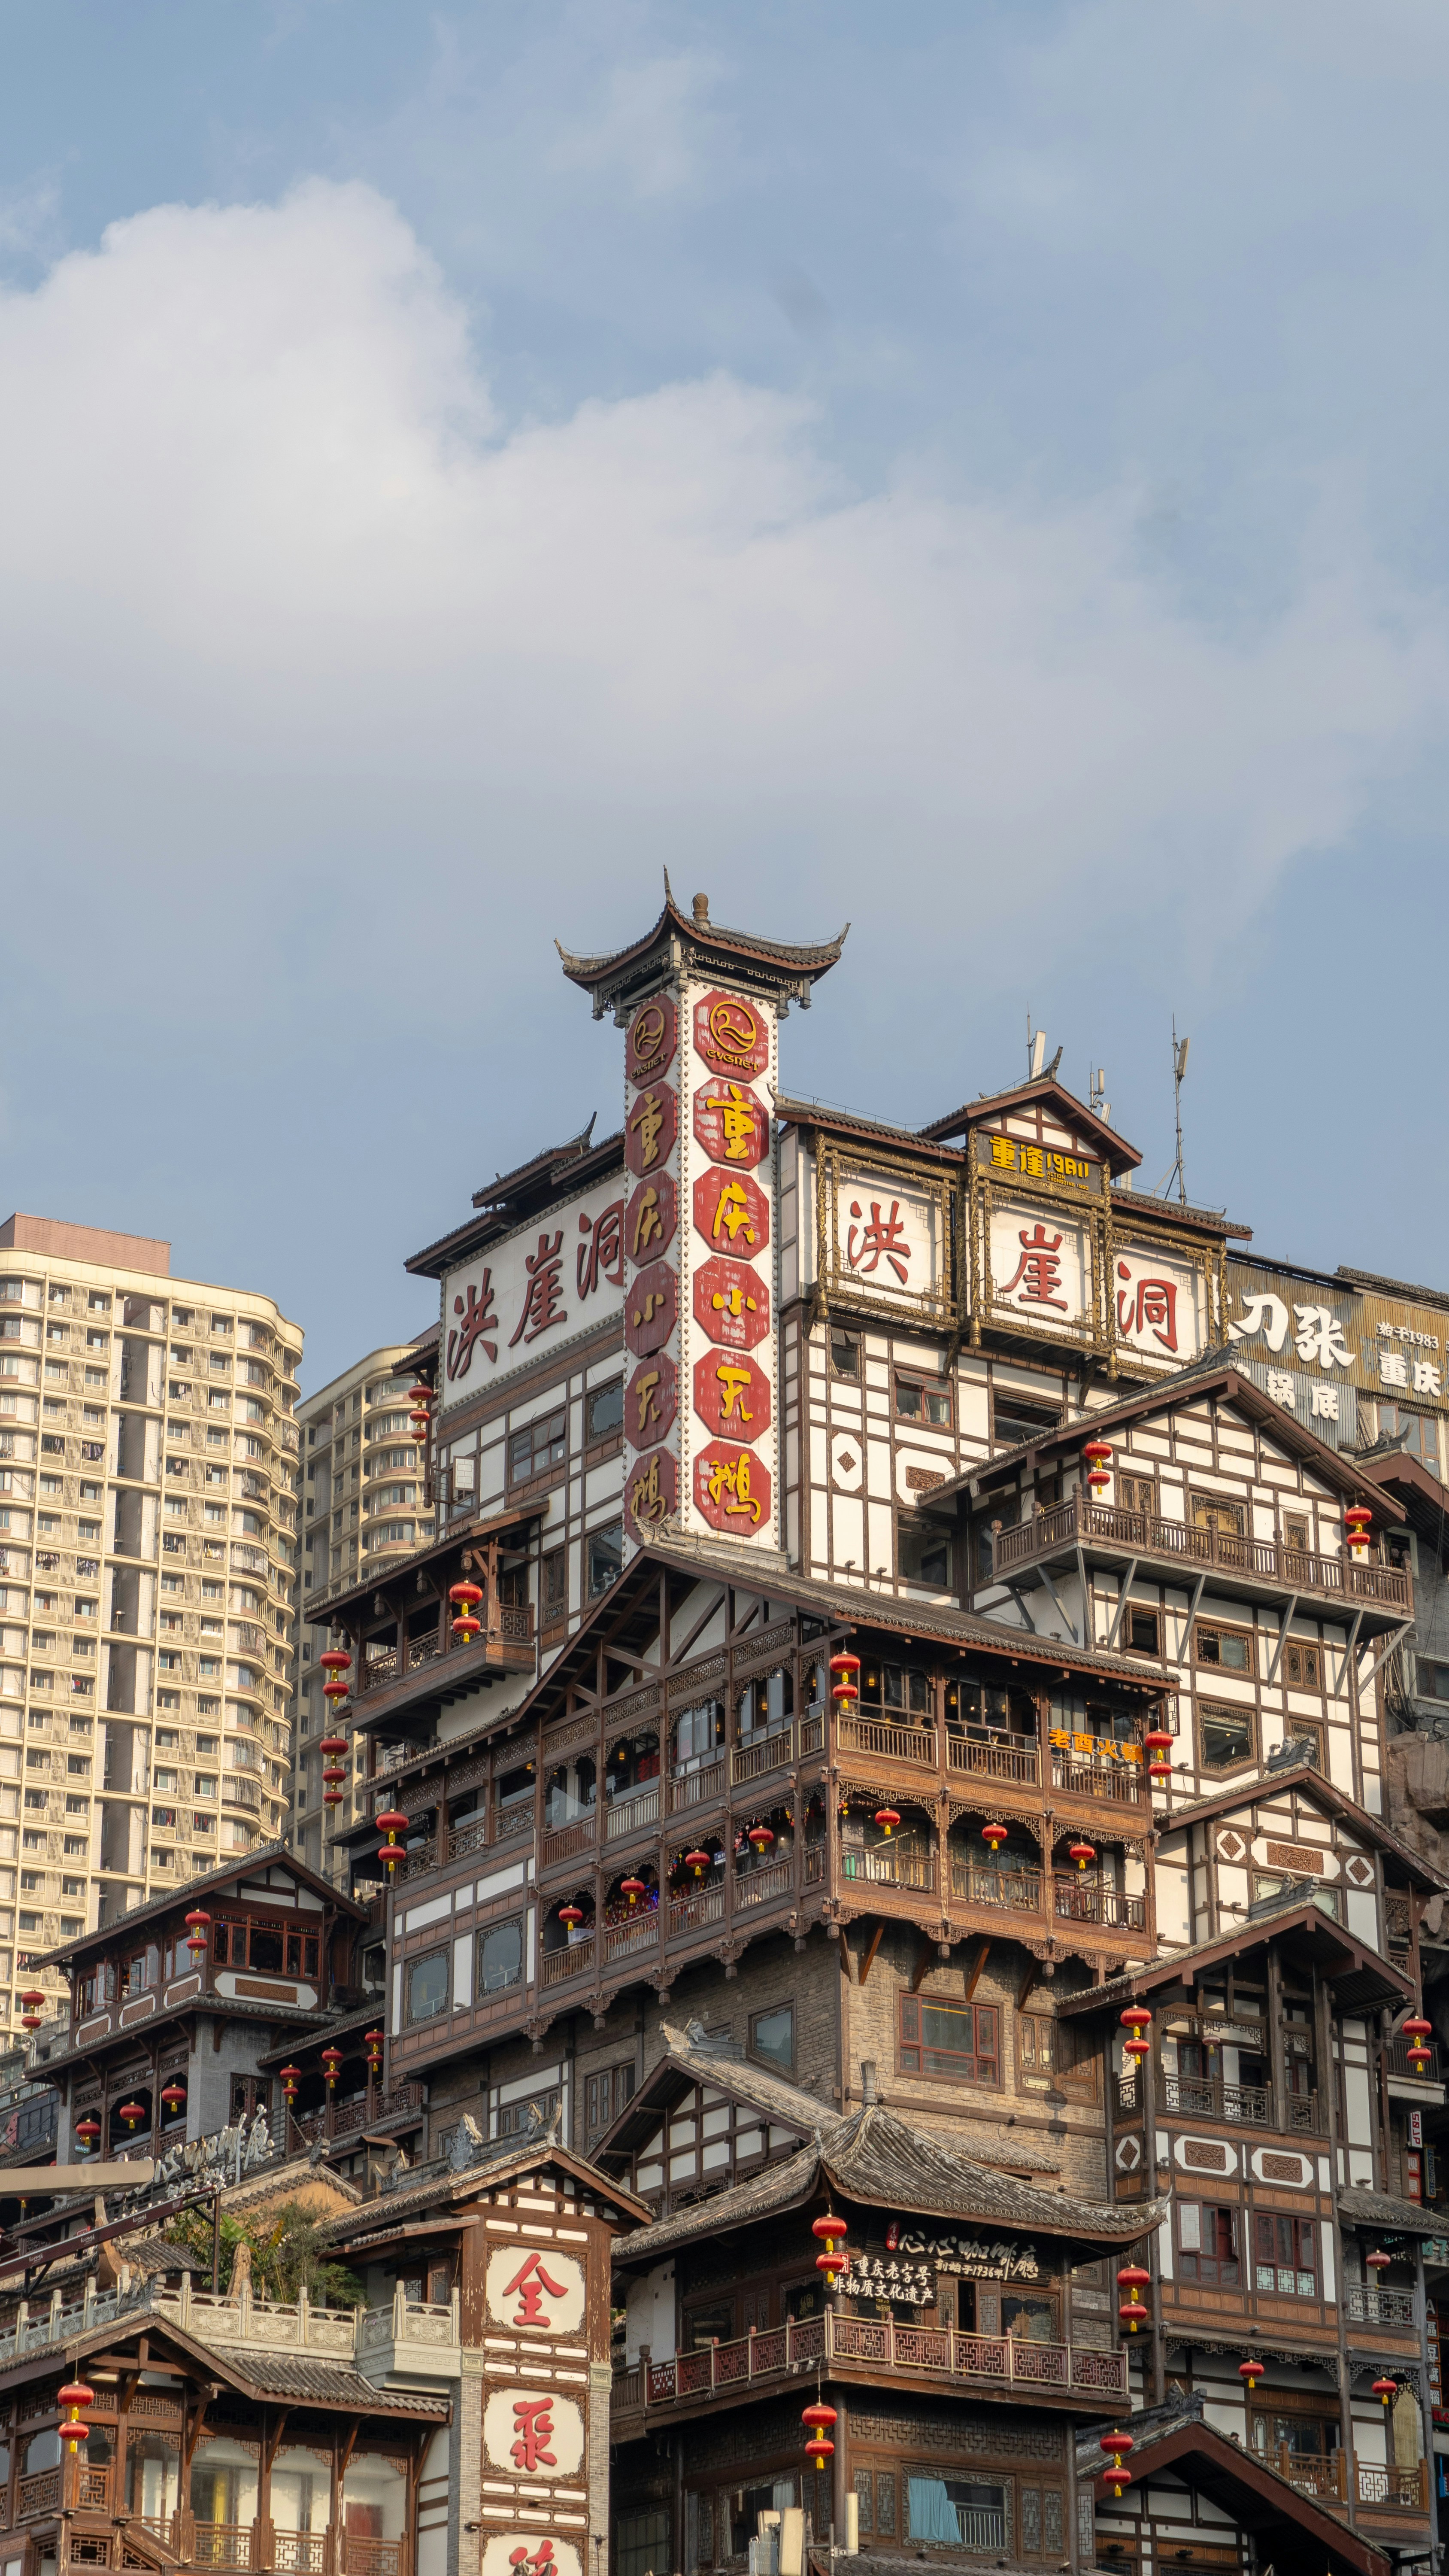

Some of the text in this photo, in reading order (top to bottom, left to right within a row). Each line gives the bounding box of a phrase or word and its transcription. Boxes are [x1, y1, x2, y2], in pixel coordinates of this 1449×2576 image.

[631, 1053, 666, 1079] CYGNET
[707, 1049, 759, 1071] CYGNET
[1047, 1171, 1065, 1179] ACTION
[446, 1198, 624, 1381] 洪崖洞
[848, 1200, 1178, 1352] 洪崖洞
[1376, 1321, 1439, 1349] 始于1983
[1379, 1351, 1441, 1397] 重庆
[1234, 1363, 1339, 1421] 锅底
[853, 2255, 931, 2286] 重庆老字号
[830, 2275, 934, 2305] 非物质文化遗产
